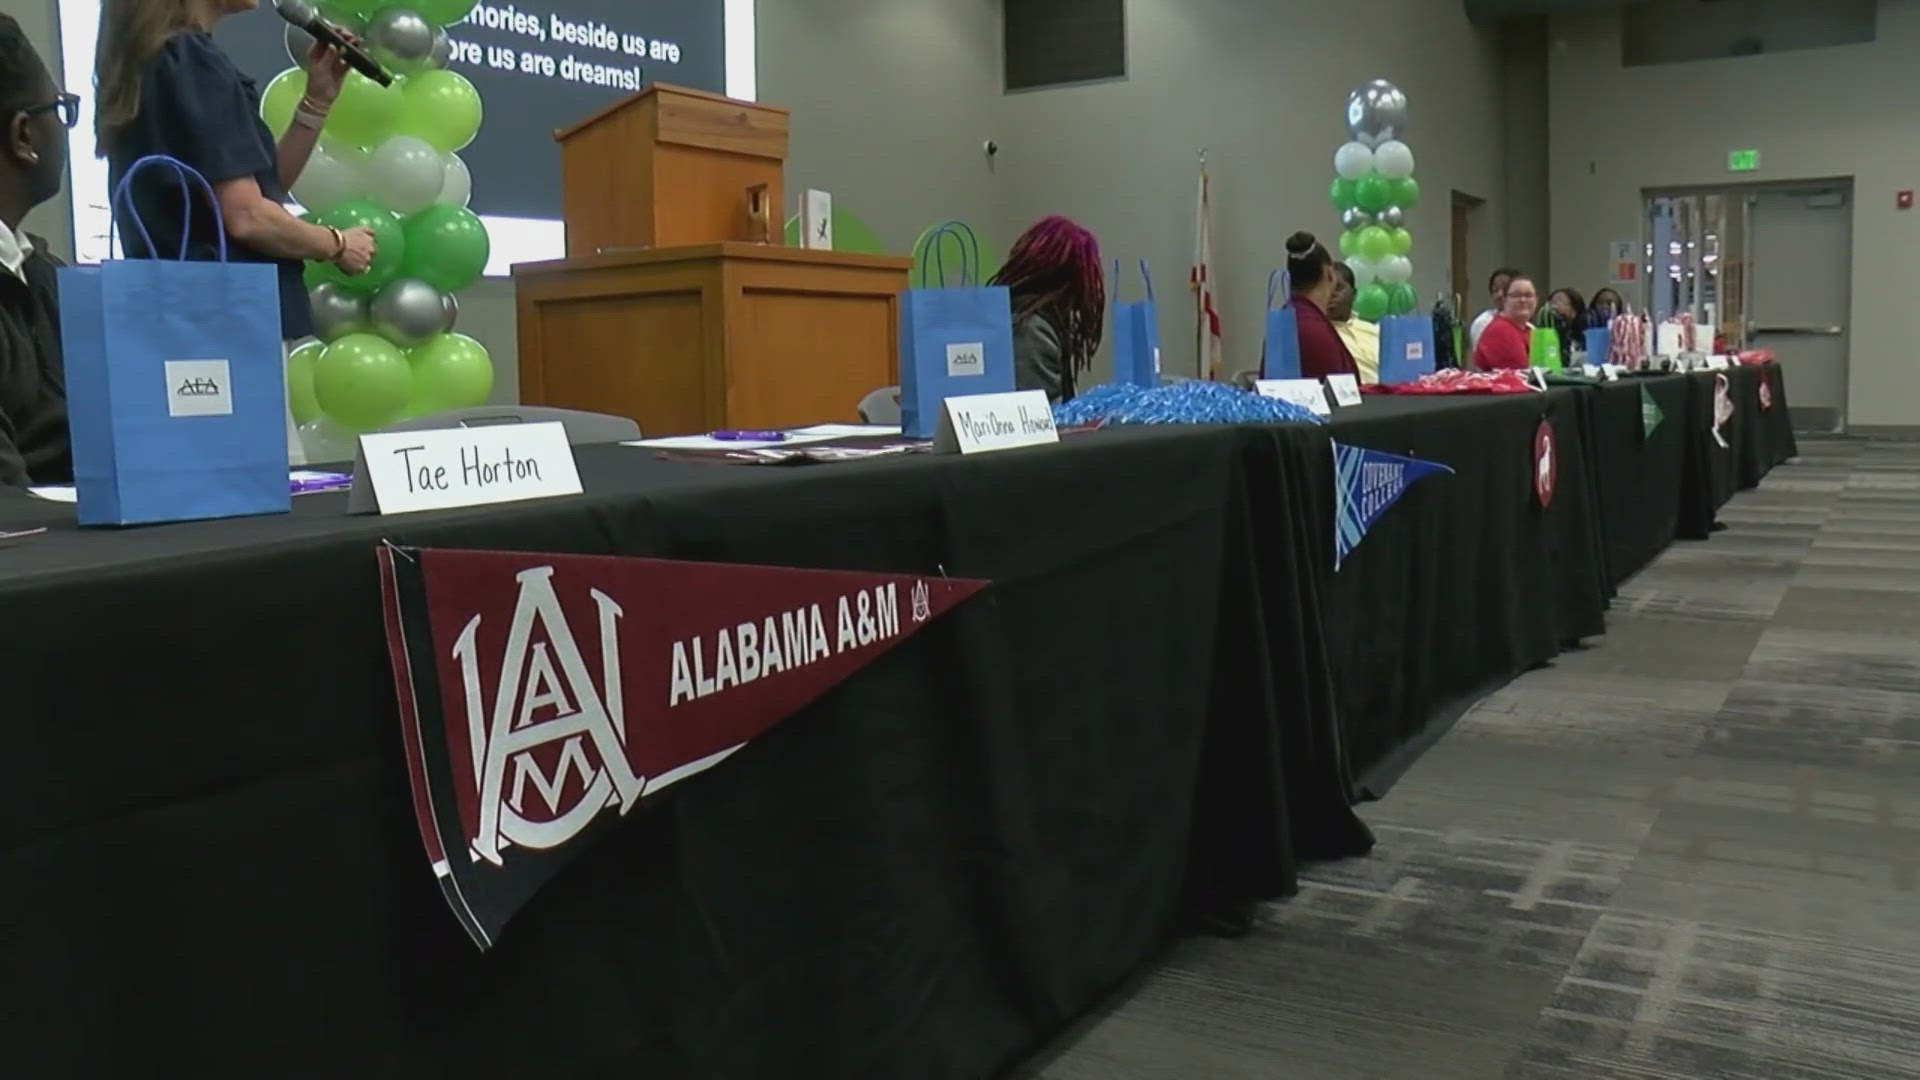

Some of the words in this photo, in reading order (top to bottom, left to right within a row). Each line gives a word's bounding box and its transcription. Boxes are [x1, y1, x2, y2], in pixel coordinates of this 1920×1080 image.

[551, 13, 618, 50] beside
[622, 34, 647, 57] us
[649, 41, 681, 64] are
[487, 46, 516, 70] us
[520, 52, 556, 76] are
[560, 54, 641, 91] dreams!
[393, 445, 450, 493] Tae
[460, 444, 543, 489] Horton
[1361, 475, 1403, 522] COLLEGE
[670, 603, 831, 707] ALABAMA
[837, 582, 900, 654] A&M
